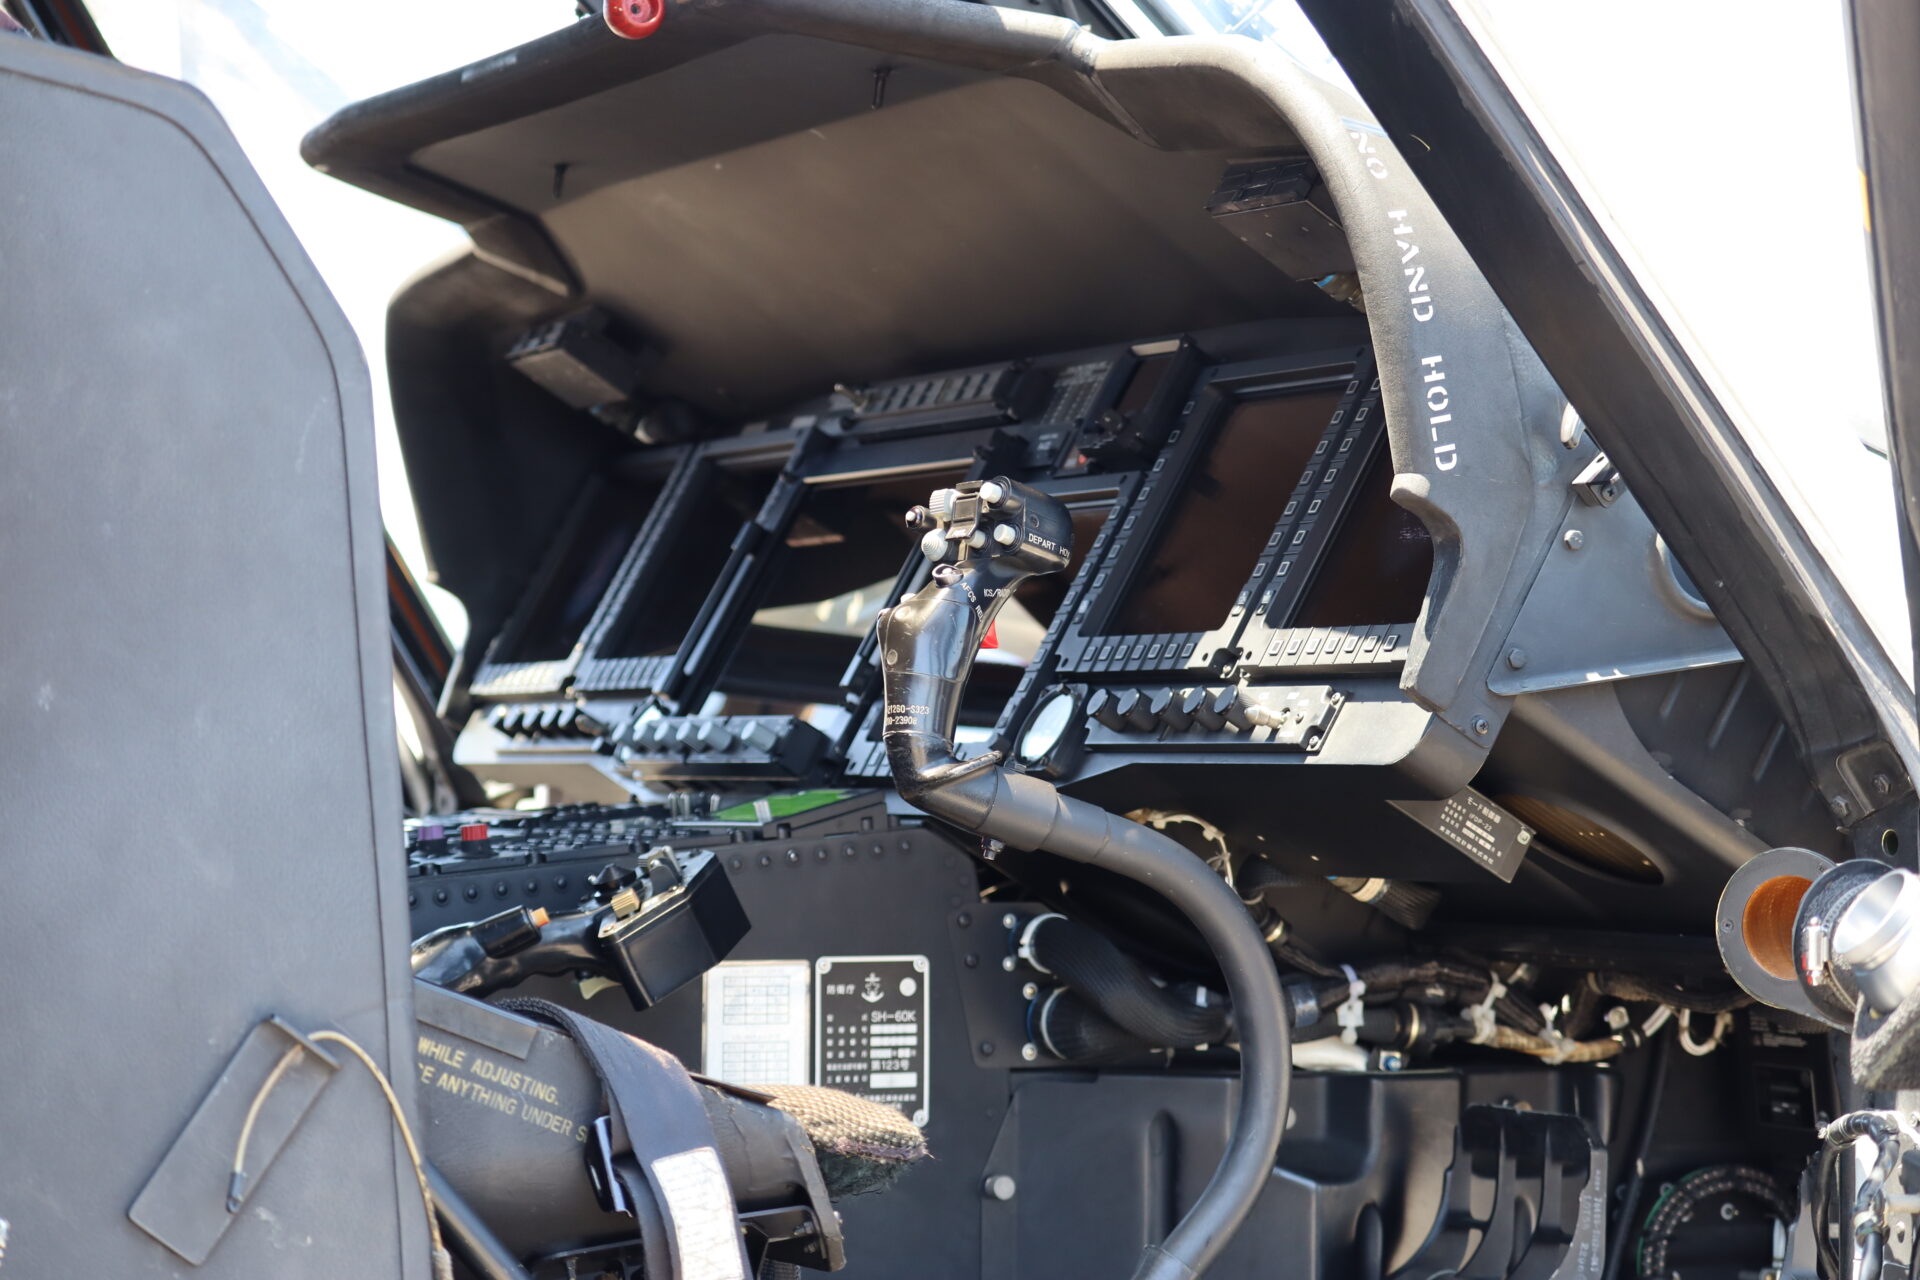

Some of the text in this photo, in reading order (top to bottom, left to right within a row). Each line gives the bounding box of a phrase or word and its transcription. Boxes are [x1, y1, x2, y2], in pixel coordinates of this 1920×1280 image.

[1350, 132, 1458, 472] NO HAND HOLD
[1028, 532, 1056, 551] DEPART
[960, 582, 977, 602] AFCS
[870, 1010, 917, 1023] SH-60K
[417, 1036, 560, 1106] WHILE ADJUSTING.
[417, 1063, 437, 1084] E
[436, 1072, 519, 1115] ANYTHING
[521, 1103, 573, 1136] UNDER
